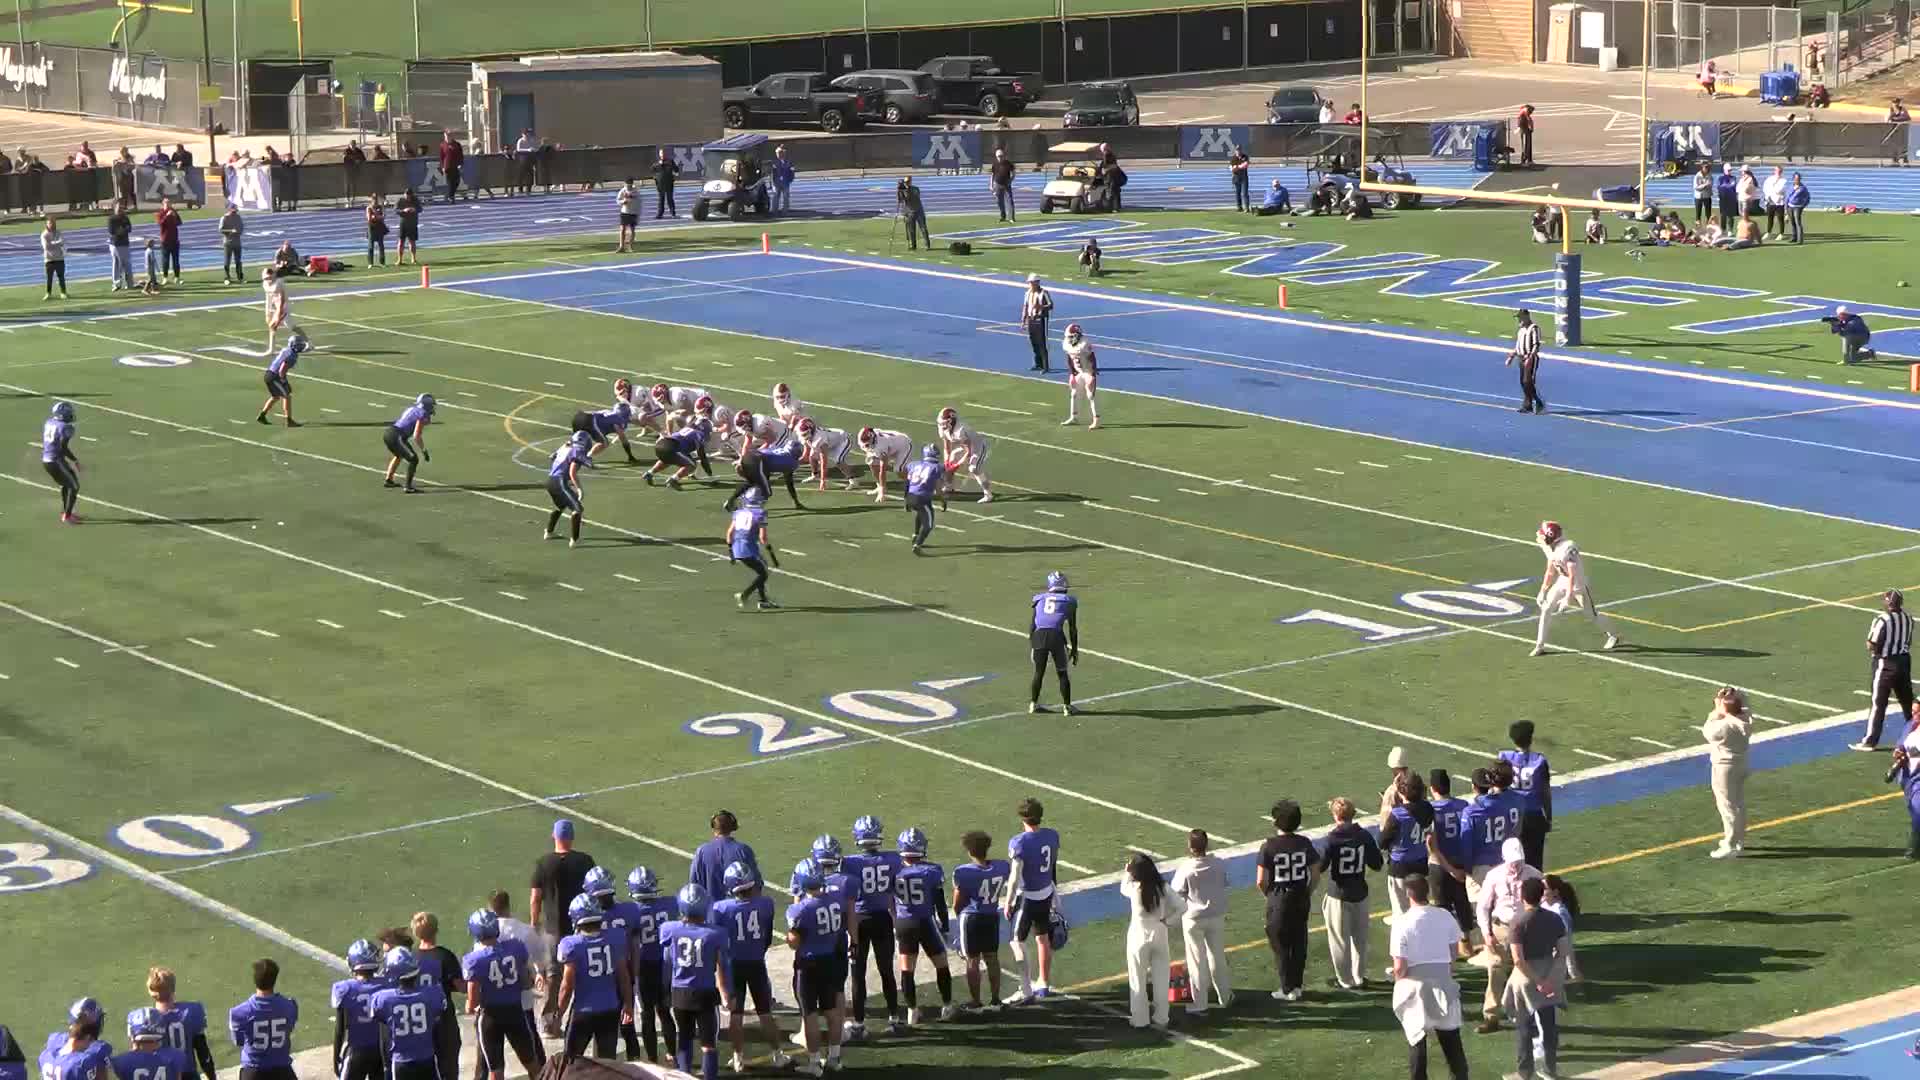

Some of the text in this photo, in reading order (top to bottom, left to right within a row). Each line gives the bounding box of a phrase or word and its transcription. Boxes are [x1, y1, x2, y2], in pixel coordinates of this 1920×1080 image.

[921, 135, 972, 165] M
[145, 169, 198, 199] M
[929, 218, 1920, 358] MINNET
[1044, 596, 1056, 614] 6
[690, 689, 958, 753] 20
[1484, 816, 1505, 843] 12
[1040, 845, 1052, 873] 3
[1273, 852, 1308, 882] 22
[1339, 846, 1367, 875] 21
[862, 864, 890, 894] 85
[978, 875, 1005, 905] 47
[735, 909, 761, 941] 14
[816, 902, 842, 935] 96
[587, 945, 614, 978] 51
[677, 936, 704, 968] 31
[488, 955, 519, 989] 43
[252, 1019, 288, 1049] 55
[392, 1002, 428, 1037] 39
